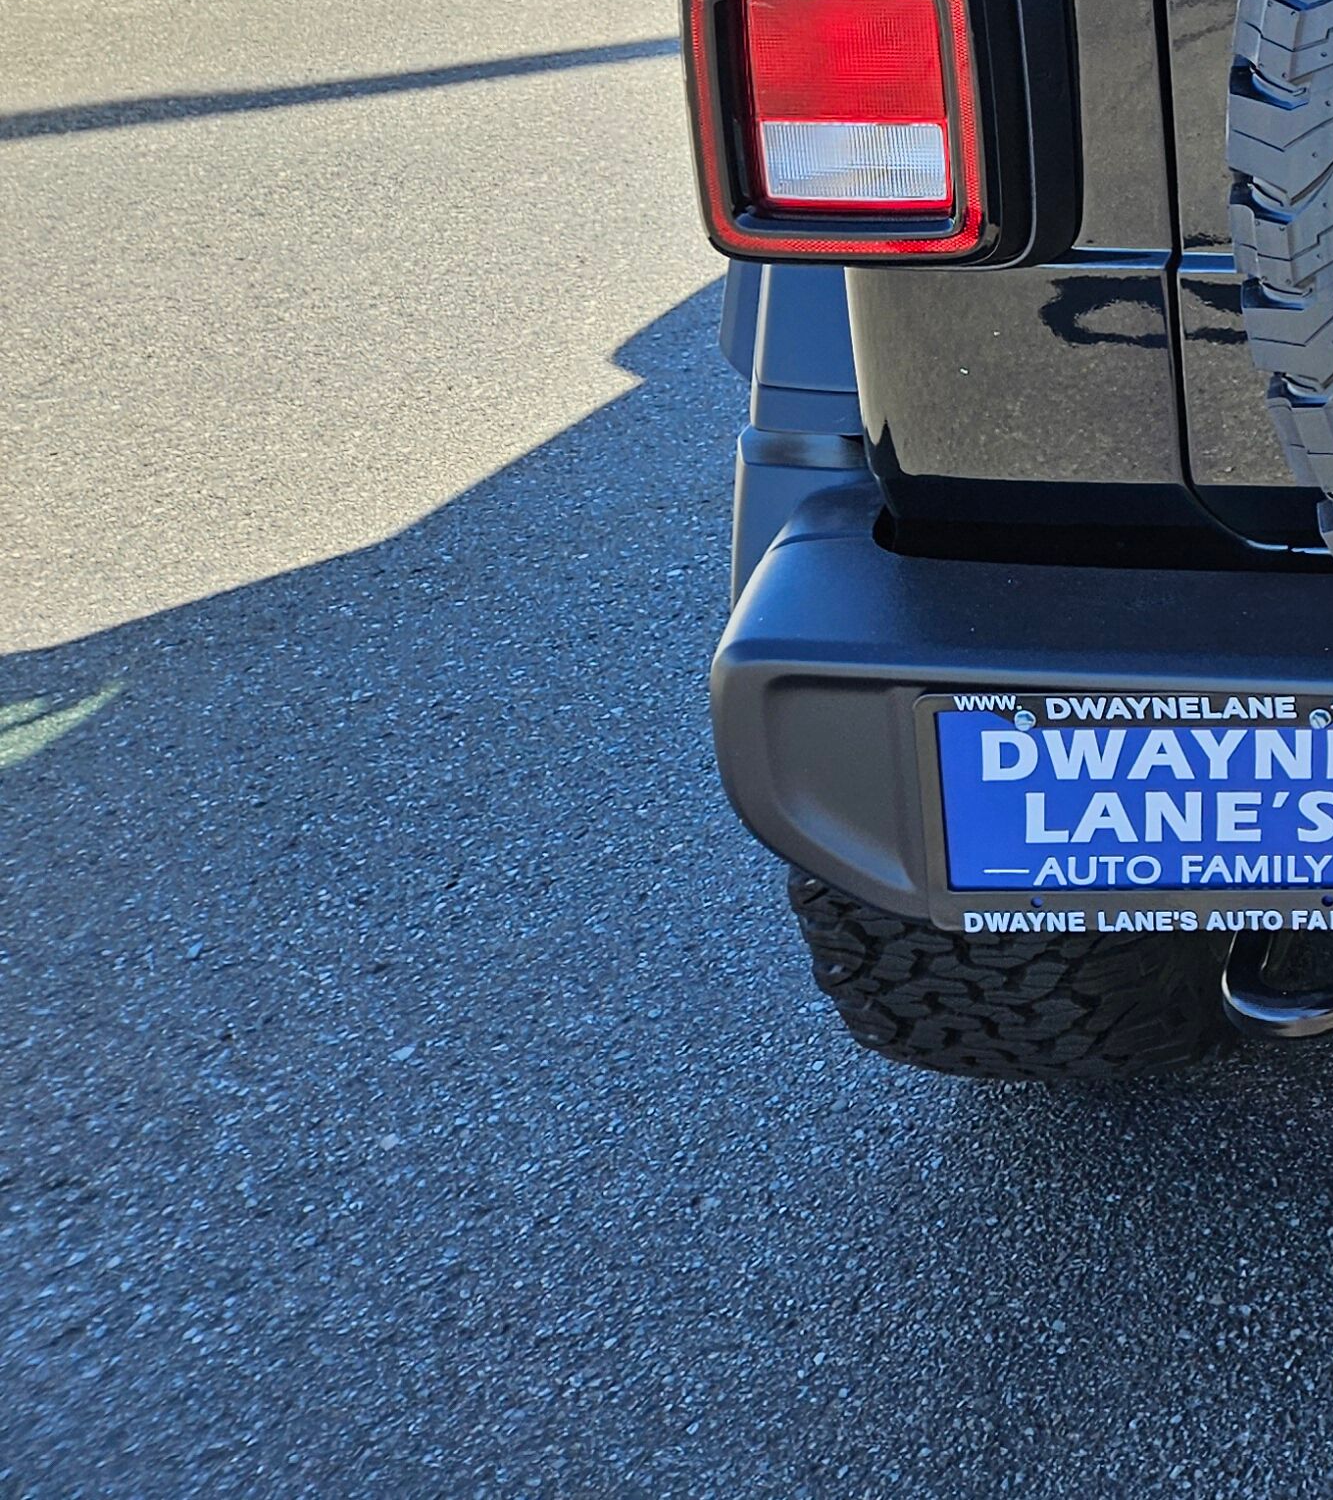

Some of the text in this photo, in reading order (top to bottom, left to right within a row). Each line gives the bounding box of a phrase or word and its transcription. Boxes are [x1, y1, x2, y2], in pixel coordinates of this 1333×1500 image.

[953, 694, 1022, 713] WWW.
[1045, 696, 1298, 721] DWAYNELANE
[1033, 854, 1333, 887] AUTO FAMILY
[963, 910, 1087, 934] DWAYNE
[1097, 909, 1200, 933] LANE'S
[1205, 909, 1284, 932] AUTO
